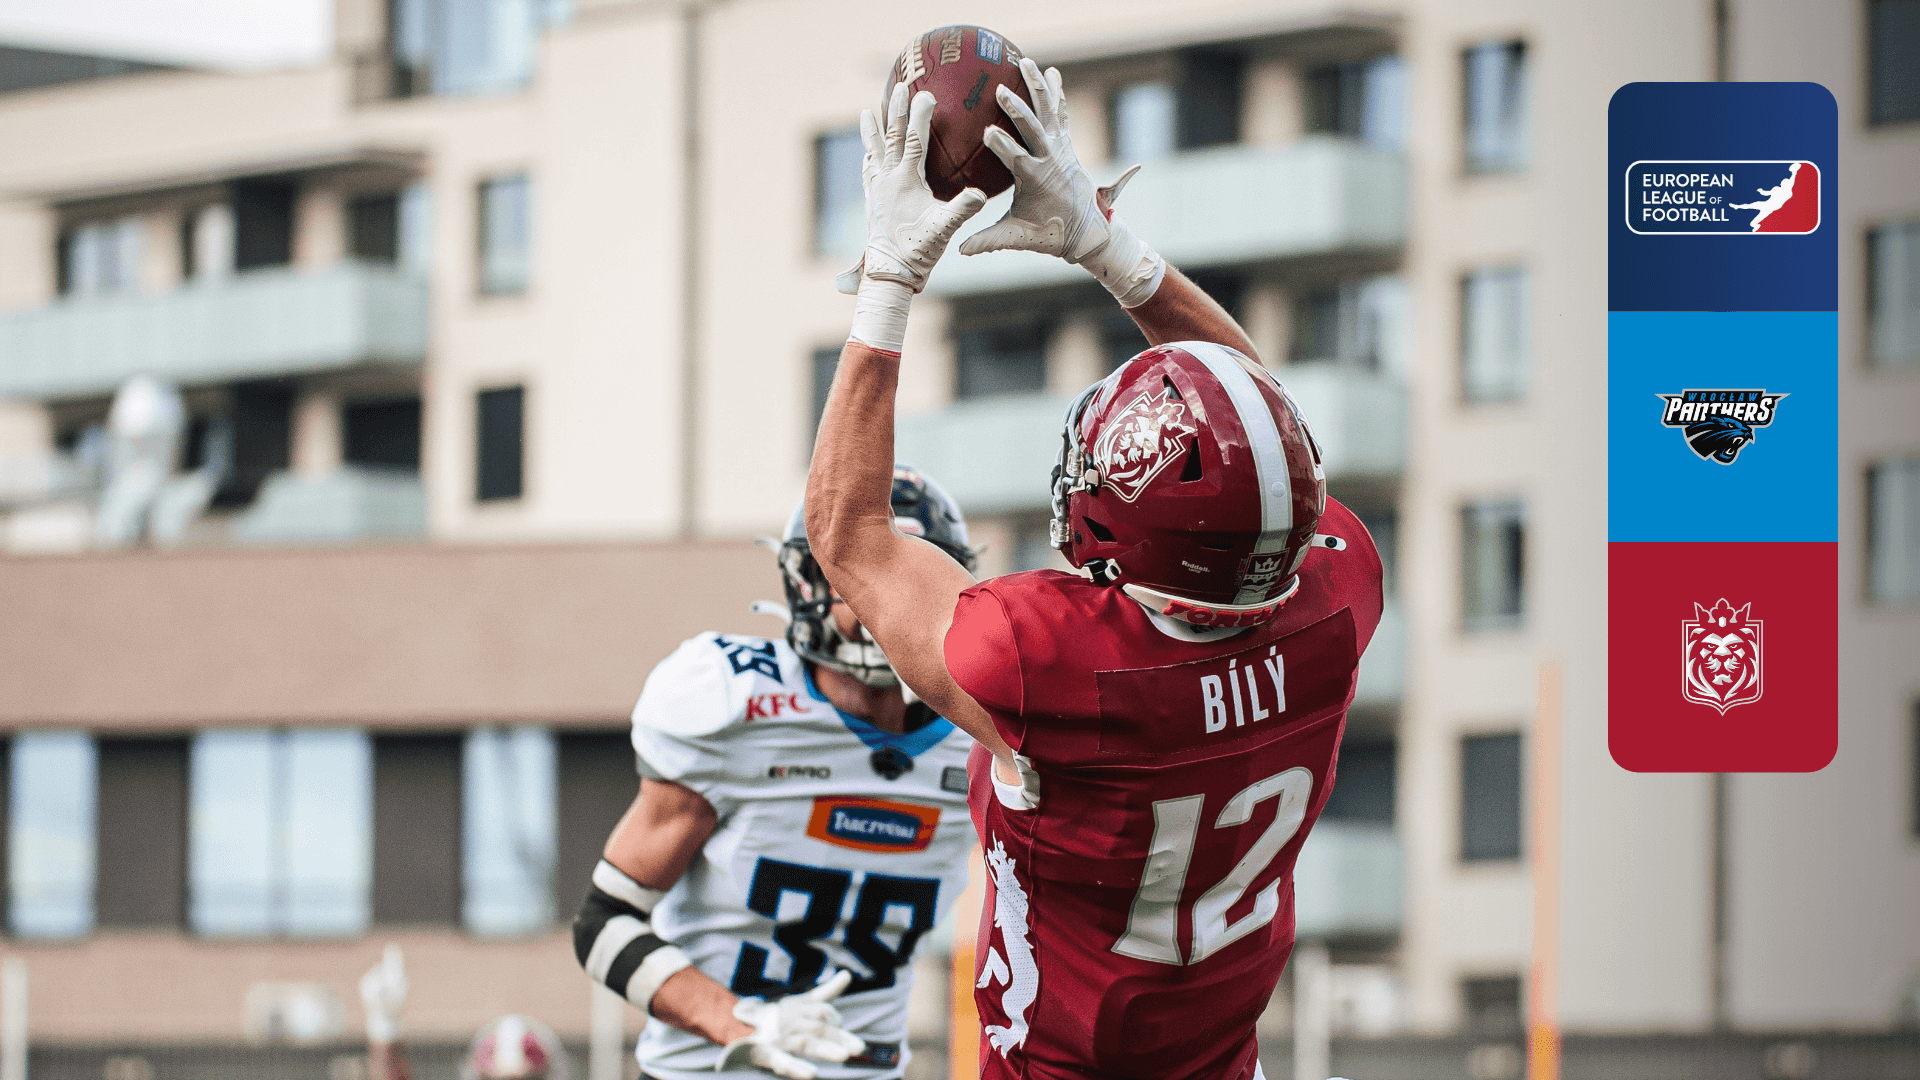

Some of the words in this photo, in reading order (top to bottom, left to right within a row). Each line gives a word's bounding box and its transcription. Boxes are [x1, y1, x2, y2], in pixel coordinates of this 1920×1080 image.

[744, 693, 812, 722] KFC
[1200, 645, 1286, 734] BÍLÝ
[1111, 766, 1314, 966] 12
